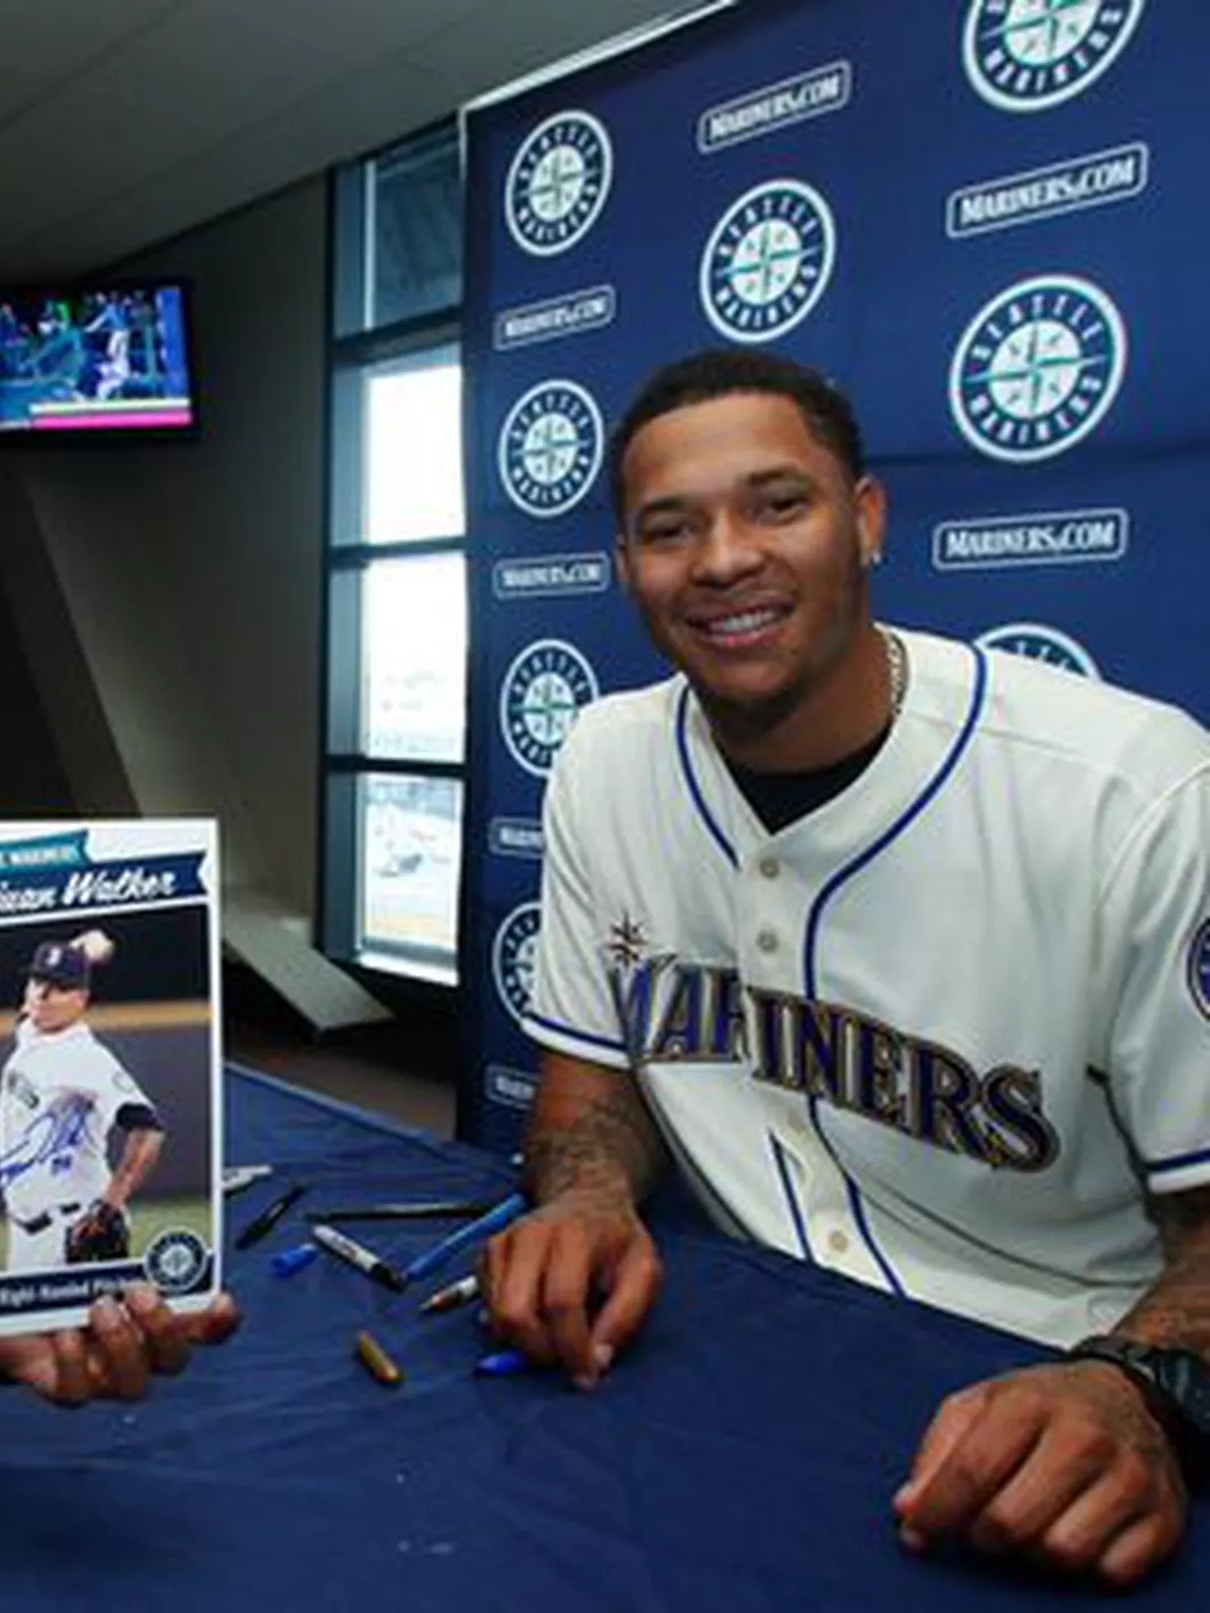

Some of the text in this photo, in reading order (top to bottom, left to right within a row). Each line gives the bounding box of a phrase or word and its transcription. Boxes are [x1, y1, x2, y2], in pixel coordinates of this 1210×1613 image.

[709, 72, 842, 139] MARINERS.COM
[960, 154, 1136, 228] MARINERS.COM
[970, 293, 1105, 361] SEATTLE
[967, 376, 1104, 446] MARINERS
[945, 520, 1115, 559] MARINERS.COM
[61, 867, 177, 906] Walker
